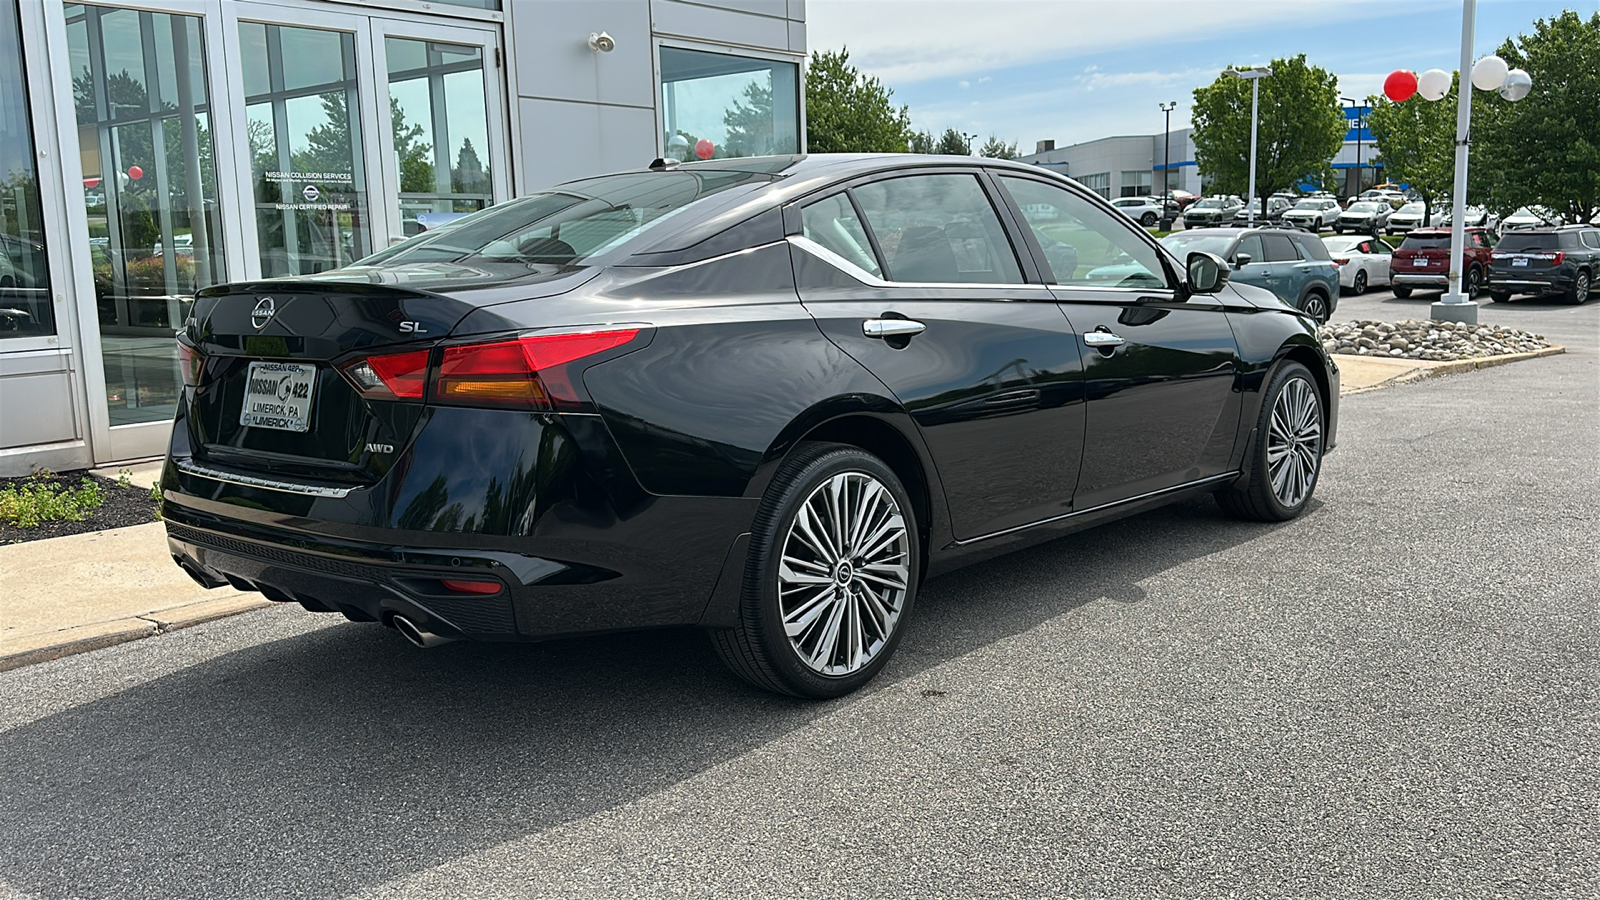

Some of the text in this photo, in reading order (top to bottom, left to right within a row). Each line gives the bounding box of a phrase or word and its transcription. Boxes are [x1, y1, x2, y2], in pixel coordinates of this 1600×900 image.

[399, 321, 428, 333] SL
[264, 363, 287, 372] NISSAN
[250, 379, 309, 399] NISSAN 422
[252, 402, 299, 417] LIMERICK, PA
[364, 443, 394, 454] AWD
